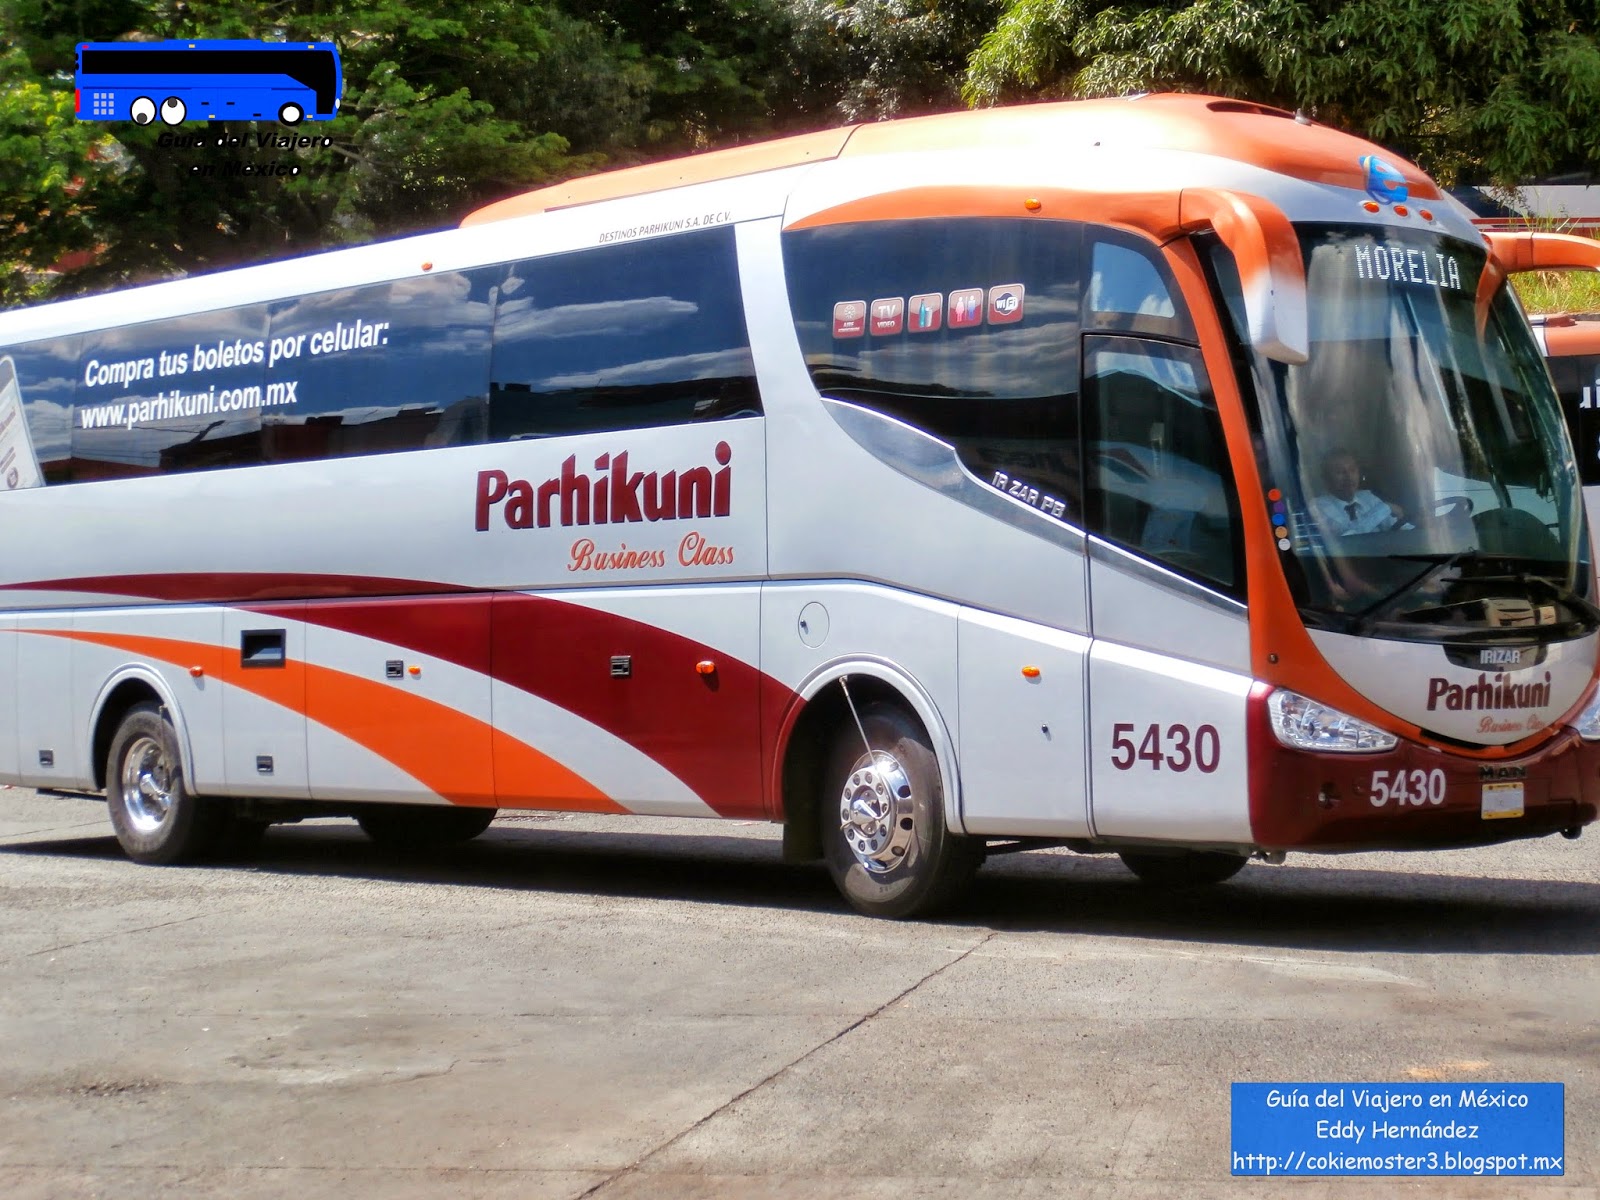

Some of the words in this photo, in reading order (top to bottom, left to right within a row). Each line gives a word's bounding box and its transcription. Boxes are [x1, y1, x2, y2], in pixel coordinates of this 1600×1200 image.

[599, 227, 638, 243] DESTINOS
[638, 219, 684, 236] PARHIKUNI
[703, 213, 715, 225] DE
[716, 211, 732, 223] C.V.
[1355, 244, 1461, 290] MORELIA
[877, 320, 896, 329] VIDEO
[878, 304, 896, 315] TV
[85, 354, 155, 388] Compra
[158, 350, 188, 377] tus
[193, 340, 264, 372] boletos
[269, 335, 307, 368] por
[310, 319, 390, 355] celular:
[81, 380, 299, 431] www.parhikuni.com.mx
[475, 440, 732, 532] Parhikuni
[567, 538, 666, 572] Business
[678, 531, 734, 567] Class
[1480, 650, 1521, 664] IRIZAR
[1427, 670, 1552, 711] Parhikuni
[1111, 723, 1221, 774] 5430
[1370, 768, 1446, 807] 5430
[1478, 765, 1528, 780] MAN
